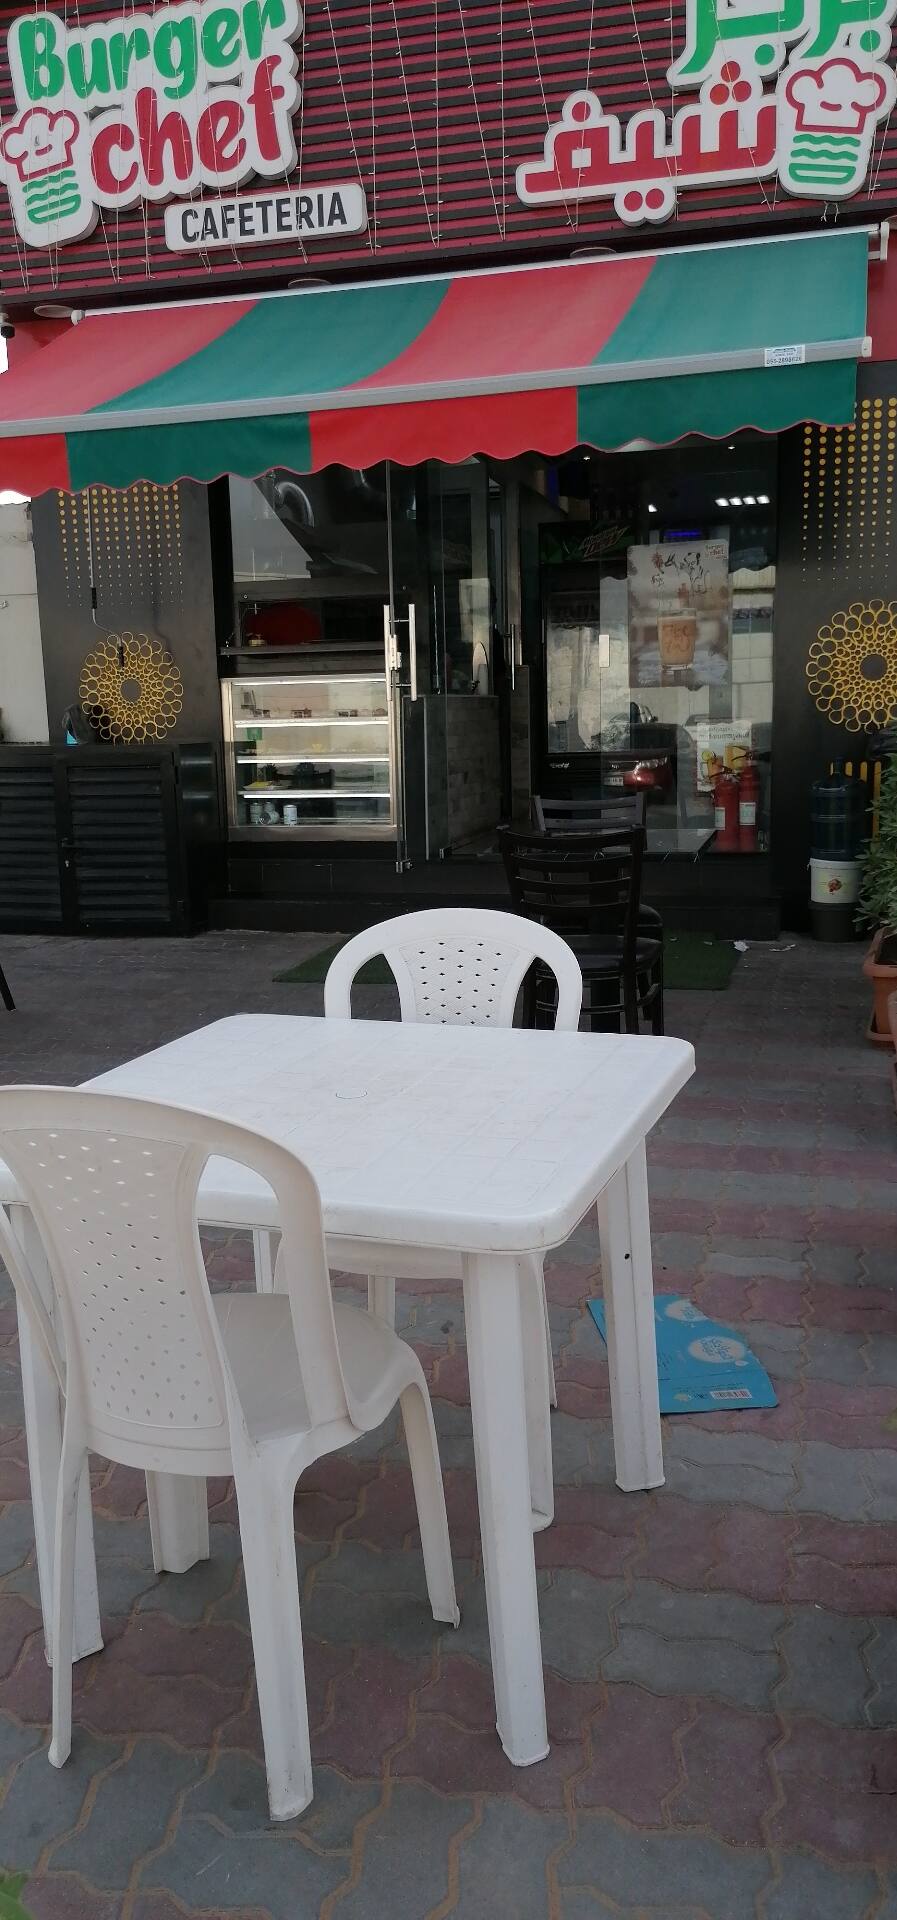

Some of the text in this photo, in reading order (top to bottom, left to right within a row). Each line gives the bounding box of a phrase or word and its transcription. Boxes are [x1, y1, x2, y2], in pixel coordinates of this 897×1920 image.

[18, 0, 287, 101] Burger
[90, 54, 285, 195] chef
[524, 60, 778, 212] شيف
[181, 191, 348, 243] CAFETERIA
